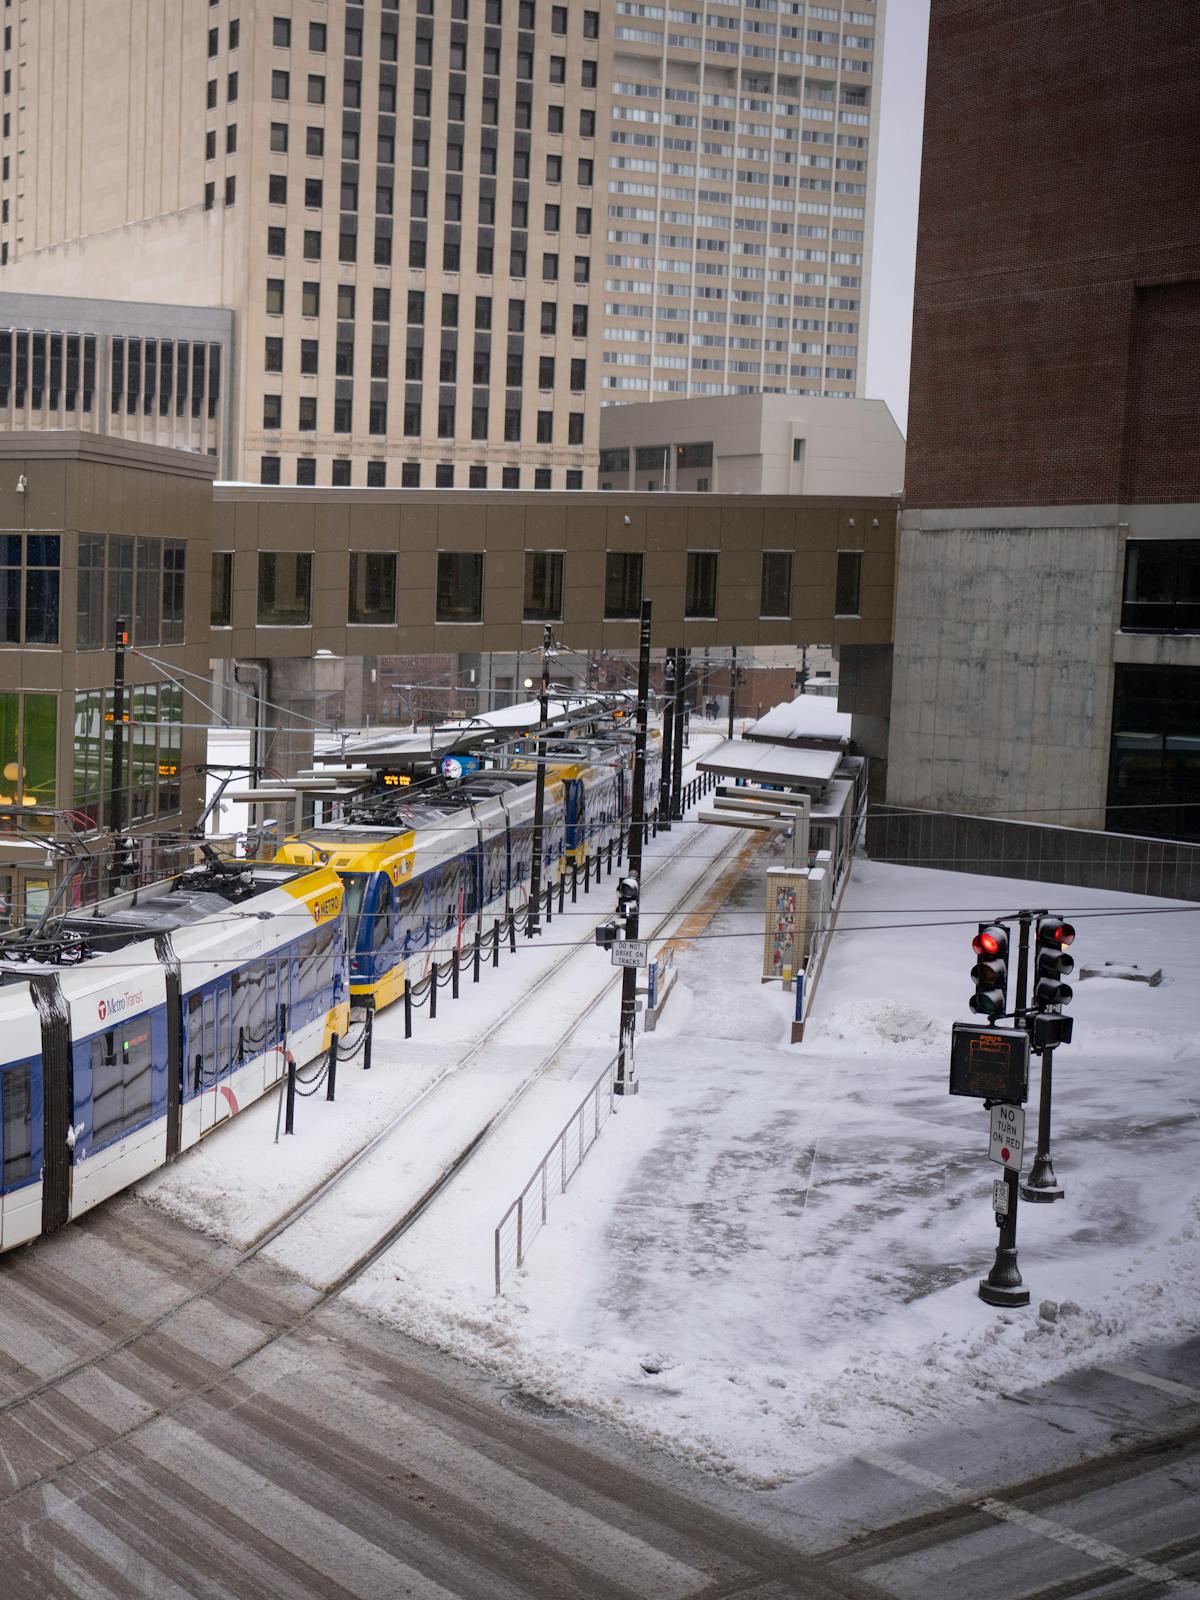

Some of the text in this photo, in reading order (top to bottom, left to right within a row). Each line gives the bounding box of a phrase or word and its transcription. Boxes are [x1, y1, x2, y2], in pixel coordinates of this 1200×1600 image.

[320, 896, 338, 914] METRO
[618, 942, 641, 951] DO NOT
[615, 950, 644, 959] DRIVE ON
[618, 957, 641, 966] TRACKS
[1000, 1107, 1015, 1122] NO
[997, 1121, 1017, 1136] TURN
[993, 1132, 1020, 1150] ON RED
